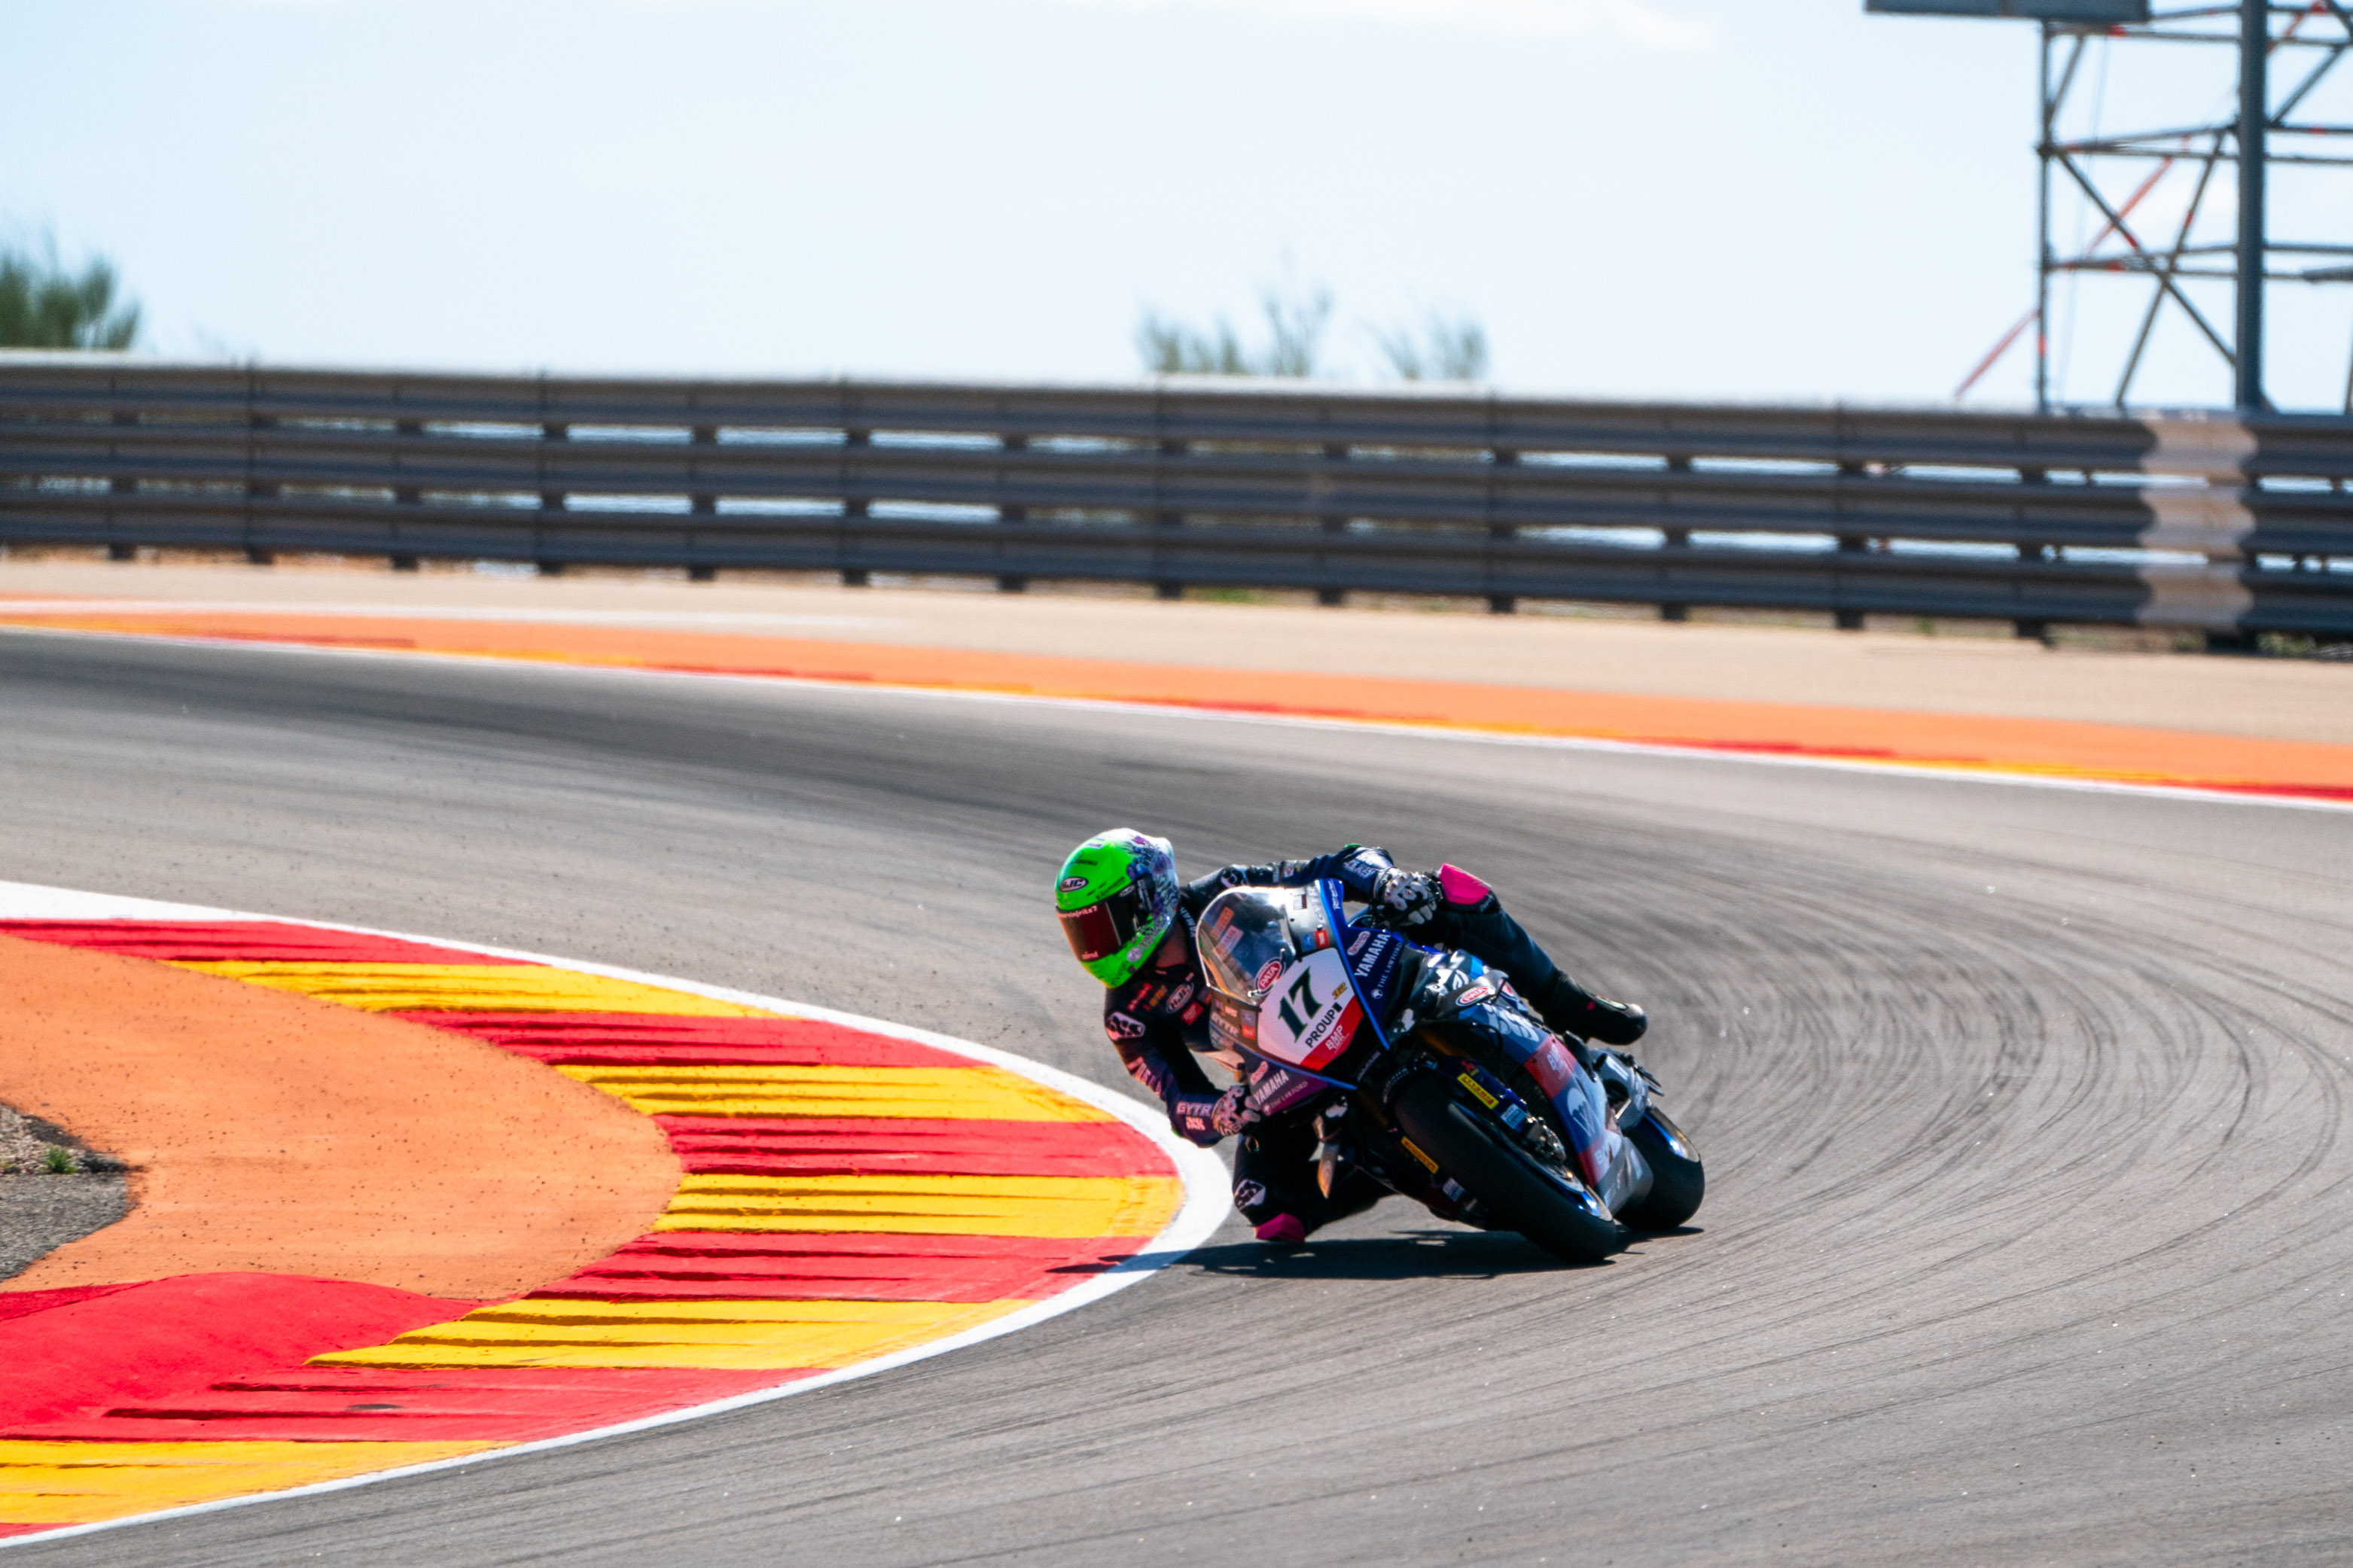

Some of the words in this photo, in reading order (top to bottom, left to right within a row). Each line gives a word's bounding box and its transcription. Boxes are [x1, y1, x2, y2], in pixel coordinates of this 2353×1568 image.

[1354, 933, 1391, 977] YAMAHA
[1377, 975, 1388, 987] THE
[1385, 942, 1402, 973] LAWFORD
[1260, 967, 1279, 988] PATA
[1278, 967, 1323, 1043] 17
[1465, 987, 1487, 1001] PATA
[1325, 1024, 1343, 1050] BMP
[1254, 1069, 1289, 1104] YAMAHA
[1176, 1101, 1212, 1116] GYTR
